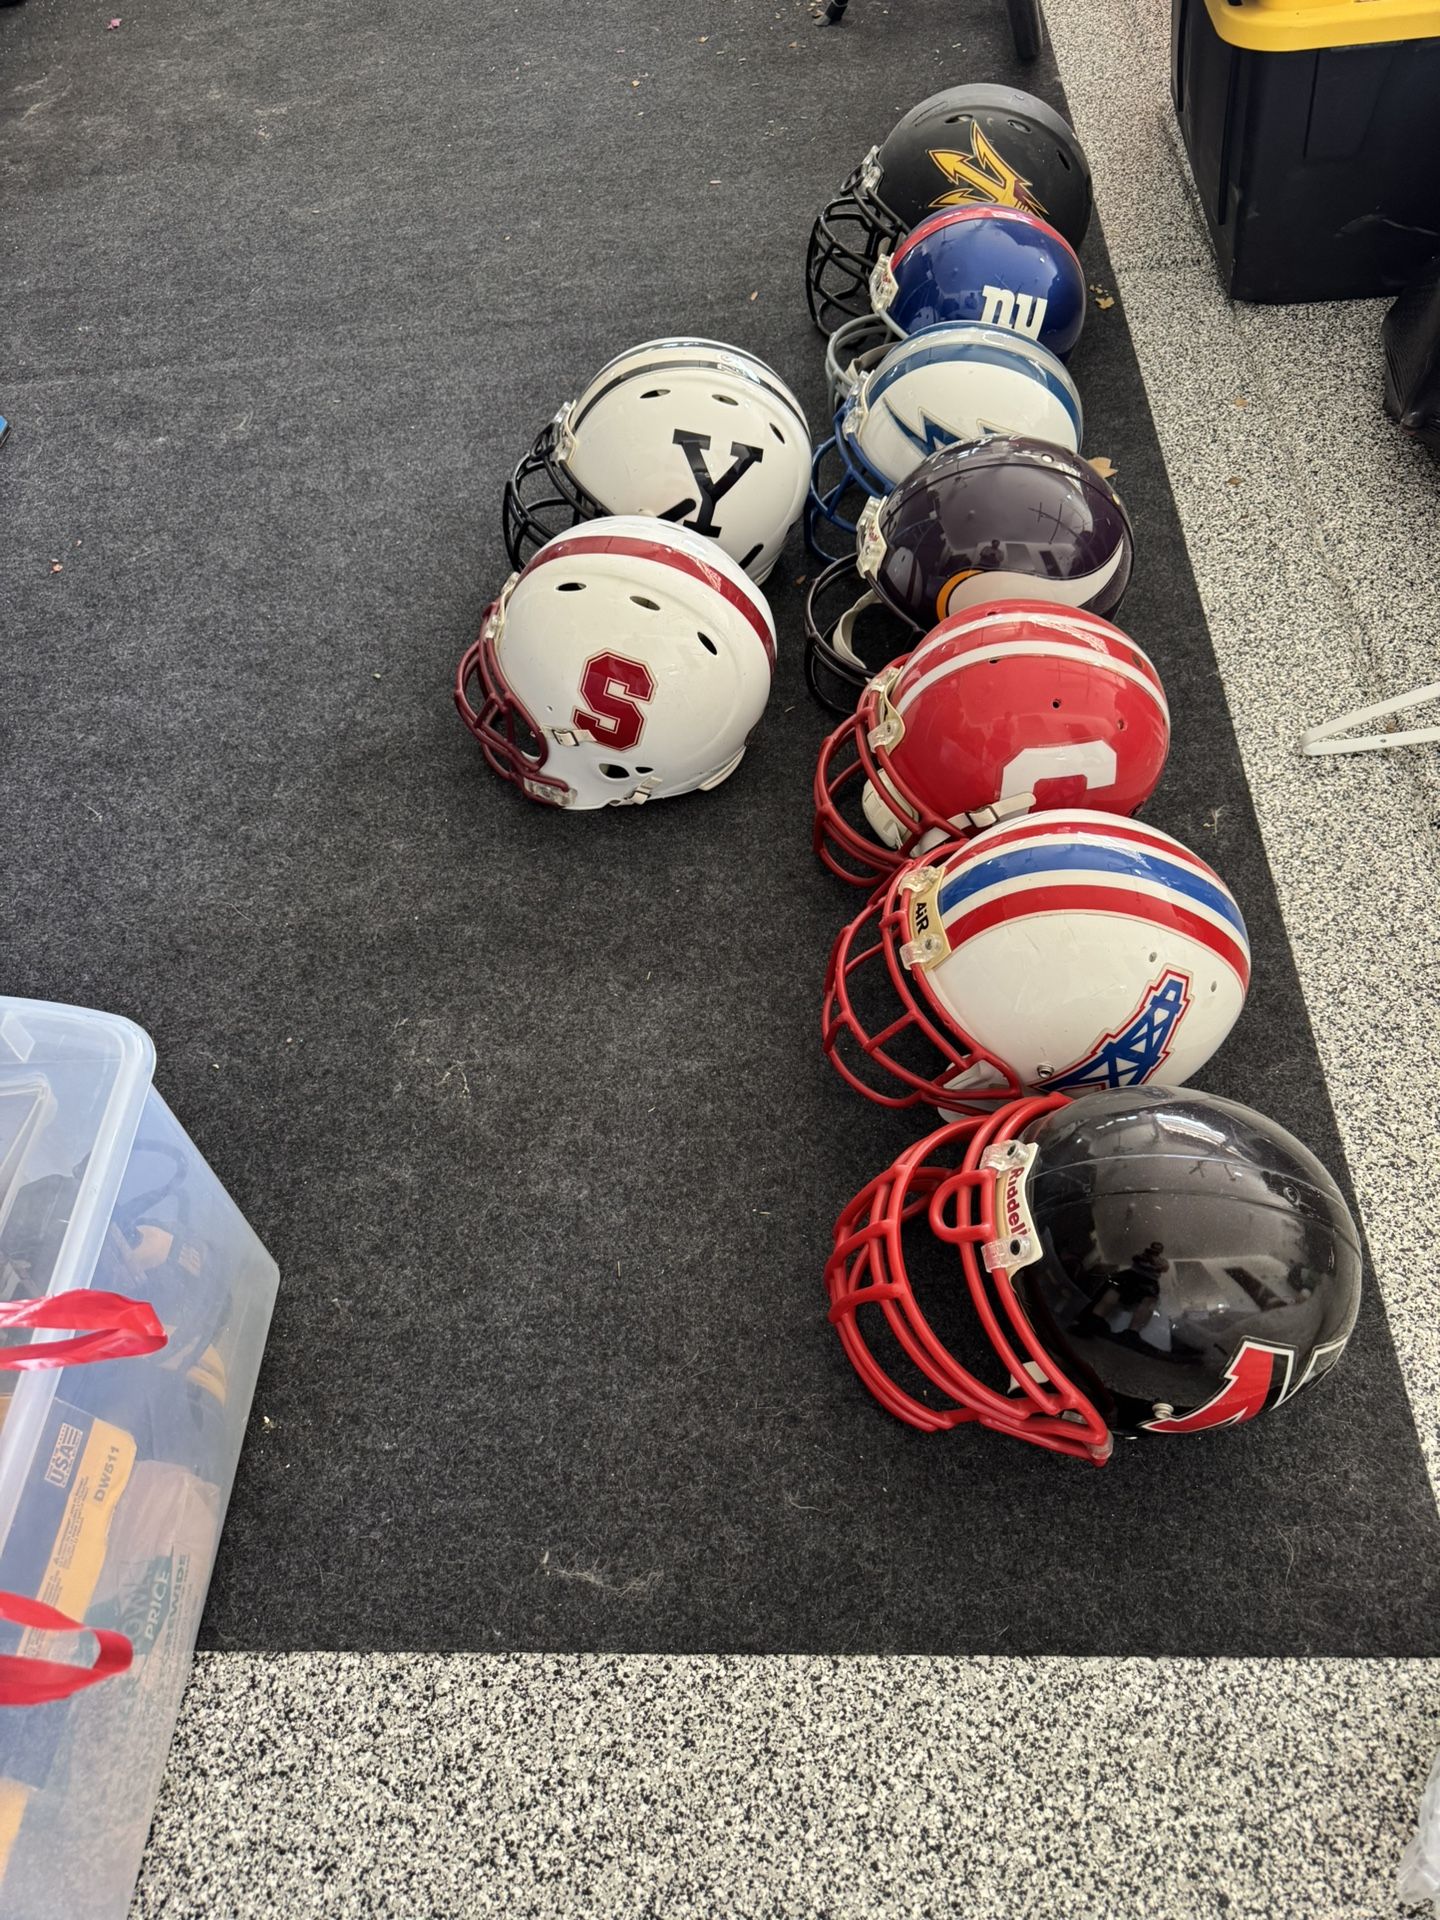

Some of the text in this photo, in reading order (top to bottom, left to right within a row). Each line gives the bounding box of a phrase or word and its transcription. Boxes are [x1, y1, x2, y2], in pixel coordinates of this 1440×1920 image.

[980, 285, 1048, 341] ny
[672, 429, 764, 538] Y
[572, 648, 658, 752] S
[50, 1446, 74, 1484] USA
[94, 1446, 119, 1502] DW511
[144, 1570, 170, 1640] PRICE
